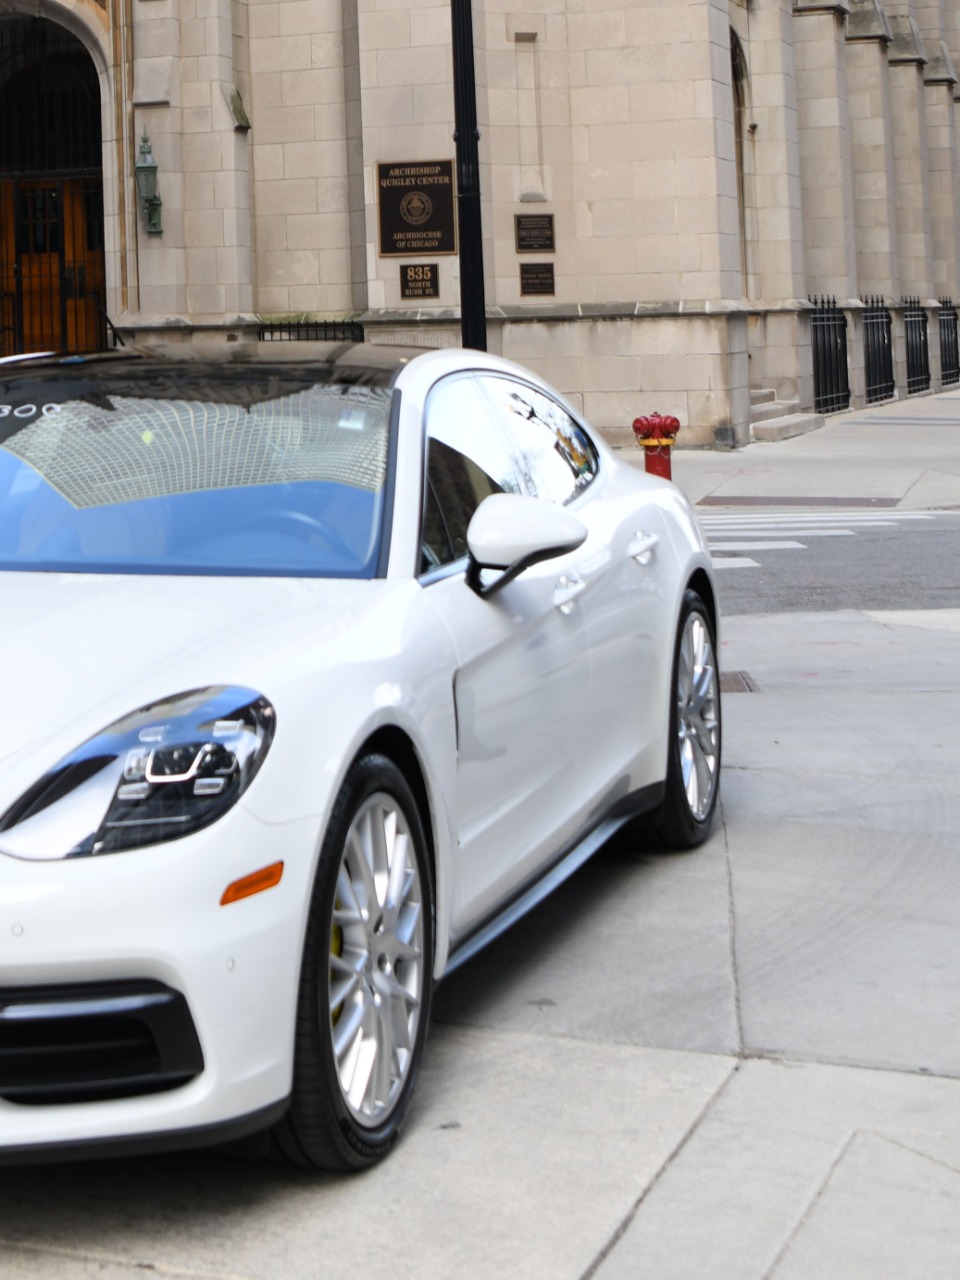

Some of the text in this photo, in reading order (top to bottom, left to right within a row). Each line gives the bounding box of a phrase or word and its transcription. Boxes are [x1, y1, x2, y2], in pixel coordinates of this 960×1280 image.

[389, 166, 441, 176] ARCHBISHOP
[381, 176, 449, 187] QUIGLEY CENTER
[393, 231, 442, 240] ARCHDIOCESE
[407, 240, 438, 248] CHICAGO
[407, 266, 431, 280] 835
